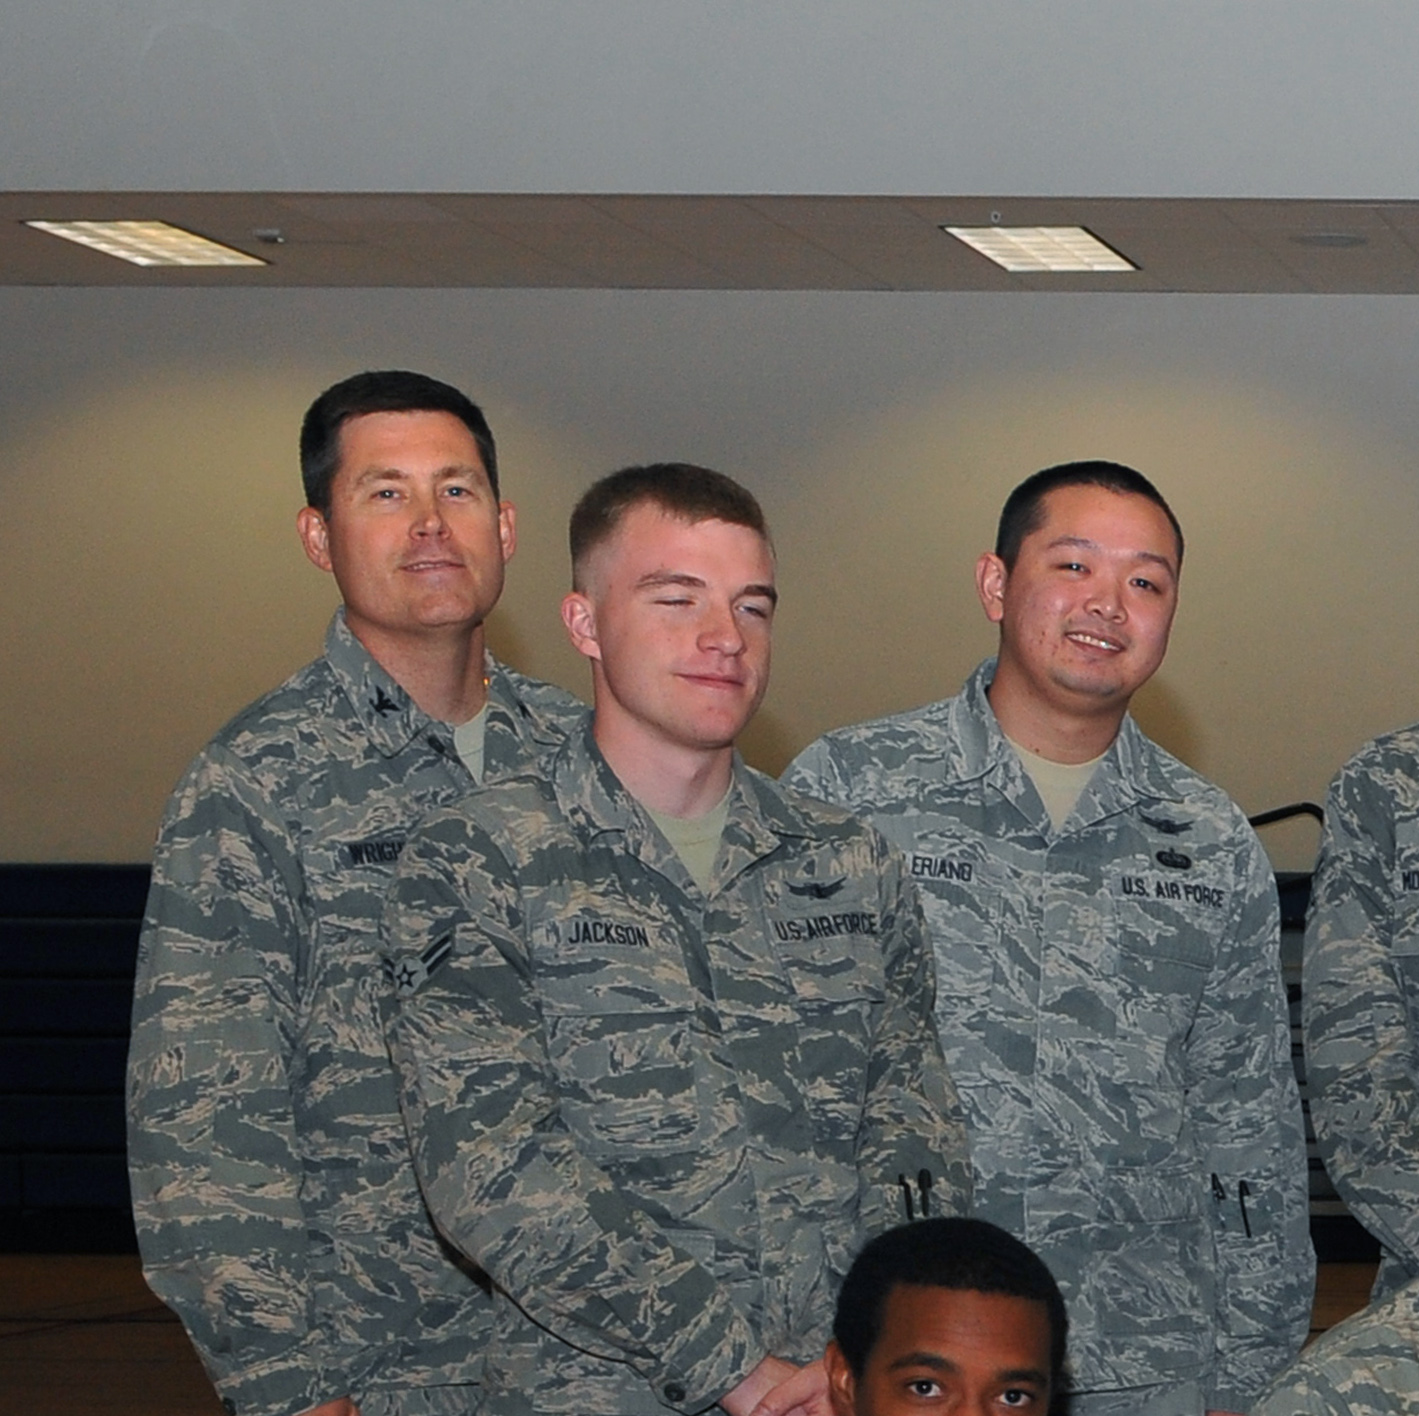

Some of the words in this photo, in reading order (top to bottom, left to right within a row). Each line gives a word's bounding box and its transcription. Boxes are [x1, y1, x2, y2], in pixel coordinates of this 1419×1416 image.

[902, 853, 973, 882] ERIANO
[1121, 877, 1149, 898] U.S.
[1156, 881, 1181, 901] AIR
[1183, 884, 1225, 908] FORCE
[568, 921, 650, 947] JACKSON
[774, 920, 807, 941] U.S.
[806, 915, 836, 939] AIR
[832, 912, 878, 936] FORCE
